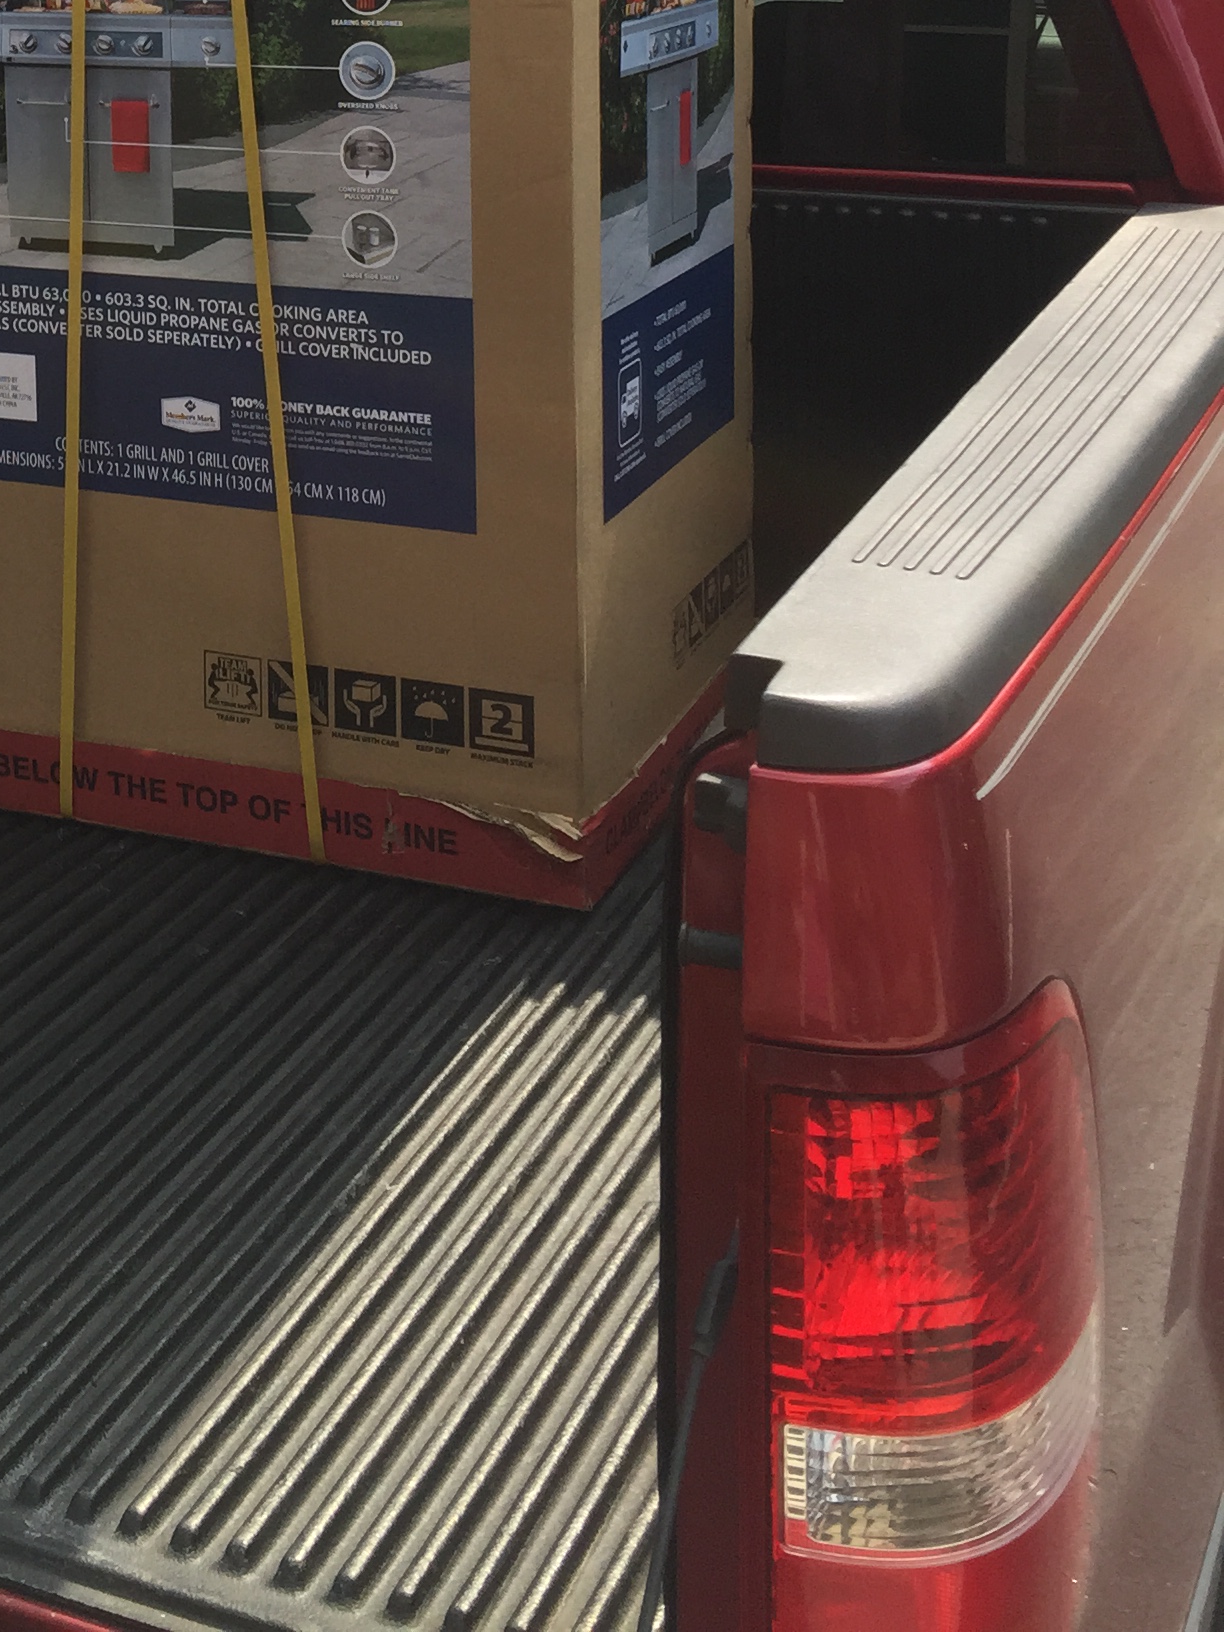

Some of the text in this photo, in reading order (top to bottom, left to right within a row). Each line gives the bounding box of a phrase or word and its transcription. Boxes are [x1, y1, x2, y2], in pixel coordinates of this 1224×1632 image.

[11, 285, 39, 299] BTU
[42, 287, 91, 304] 63,00
[105, 291, 144, 308] 603.3
[147, 295, 172, 311] SQ.
[176, 296, 195, 312] IN.
[198, 298, 246, 316] TOTAL
[249, 301, 322, 322] COKING
[325, 308, 369, 325] AREA
[12, 318, 103, 338] (CONVETER
[106, 325, 144, 342] SOLD
[147, 329, 241, 351] SEPERATELY)
[255, 339, 296, 355] GILL
[298, 342, 350, 359] COVER
[352, 344, 432, 365] INCLUDED
[76, 306, 104, 322] SES
[107, 309, 157, 326] LIQUID
[161, 313, 229, 332] PROPANE
[232, 319, 262, 335] GAS
[293, 323, 377, 344] CONVERTS
[381, 329, 404, 346] TO
[230, 396, 432, 425] 100% ONEY BACK GUARANTEE
[230, 409, 272, 421] SUPERIO
[283, 414, 327, 426] QUALITY
[329, 419, 352, 429] AND
[355, 421, 432, 437] PERFORMANCE
[55, 436, 270, 474] COTENTS: 1 GRILL AND 1 GRILL COVER
[96, 460, 105, 475] X
[106, 461, 131, 478] 21.2
[133, 464, 146, 480] IN
[147, 465, 160, 481] W
[162, 466, 170, 483] X
[171, 468, 197, 486] 46.5
[199, 471, 212, 487] IN
[214, 473, 223, 488] H
[225, 474, 252, 492] (130
[254, 477, 274, 494] CM
[304, 482, 323, 499] CM
[325, 485, 334, 500] X
[338, 486, 360, 503] 118
[361, 488, 386, 508] CM)
[490, 703, 513, 736] 2
[107, 770, 168, 804] THE
[176, 782, 239, 814] TOP
[247, 794, 291, 824] OF
[301, 803, 373, 841] HIS
